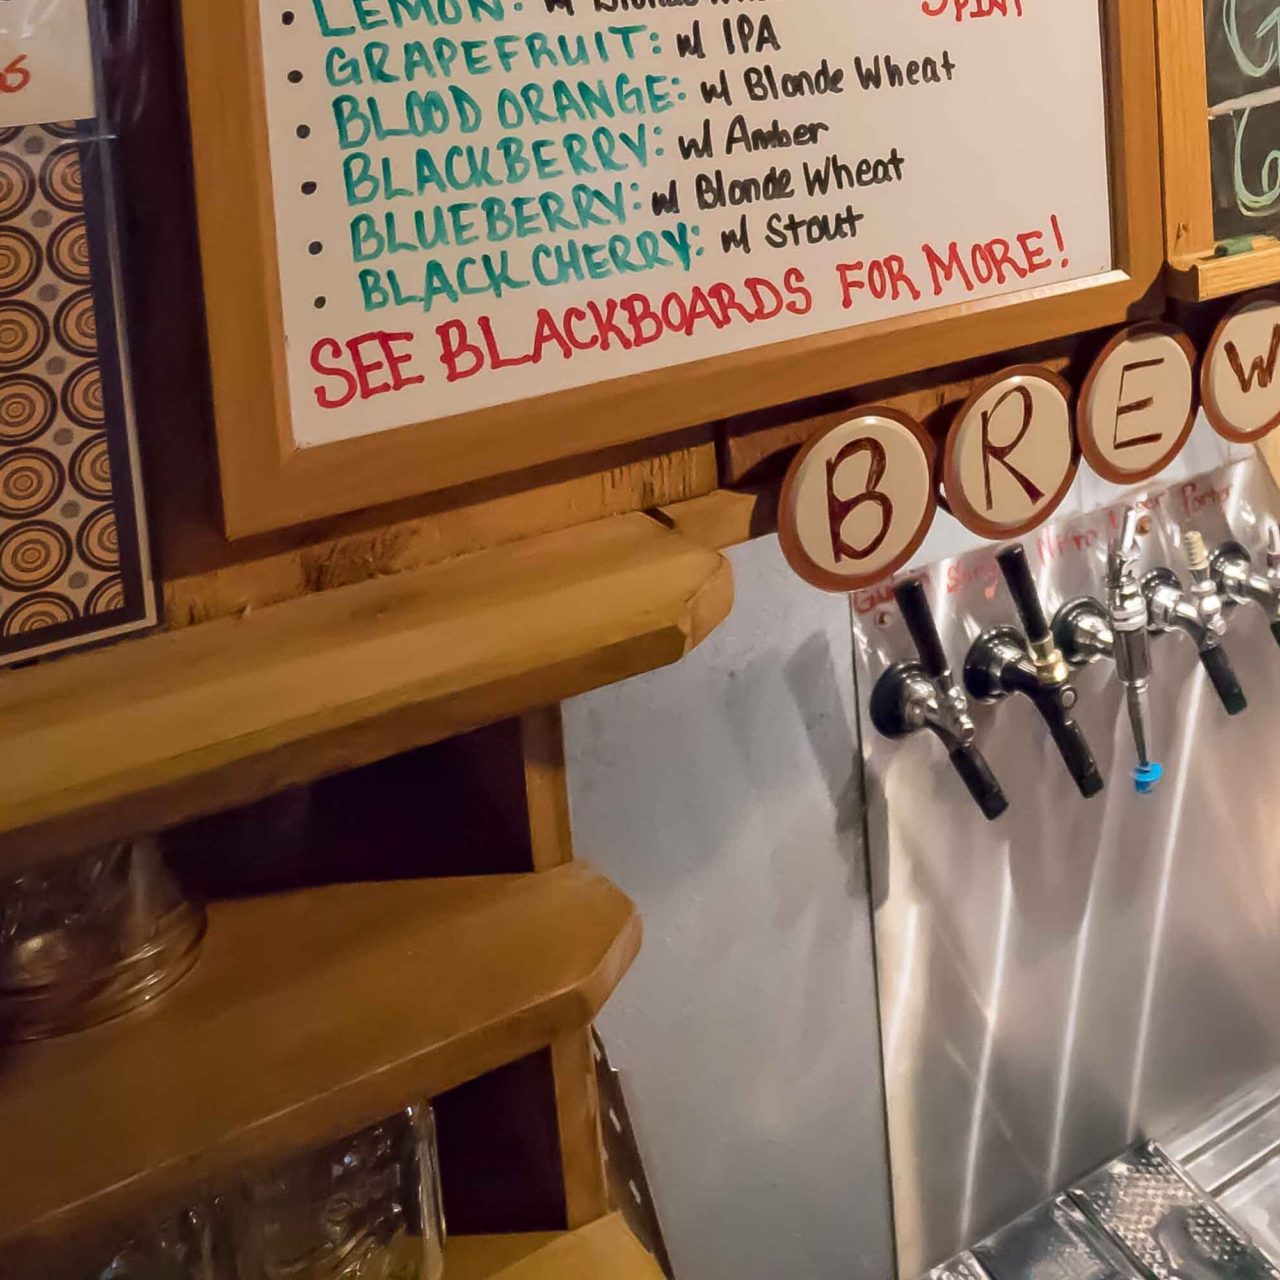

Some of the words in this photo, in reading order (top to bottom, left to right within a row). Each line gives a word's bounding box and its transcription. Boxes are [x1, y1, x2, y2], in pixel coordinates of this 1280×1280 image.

[323, 24, 663, 89] GRAPEFRUIT:
[721, 13, 782, 57] IPA
[331, 84, 483, 151] BLOOD
[496, 71, 688, 130] ORANGE:
[743, 58, 845, 104] Blonde
[853, 49, 957, 92] Wheat
[341, 121, 666, 208] BLACKBERRY:
[724, 114, 831, 157] Amber
[349, 180, 643, 265] BLUEBERRY:
[694, 166, 796, 212] Blonde
[802, 146, 907, 199] Wheat
[309, 329, 426, 410] SEE
[434, 266, 815, 384] BLACKBOARDS
[835, 253, 923, 310] FOR
[920, 213, 1071, 296] MORE!
[357, 248, 533, 314] BLACK
[531, 220, 706, 289] CHERRY:
[763, 204, 866, 251] Stout
